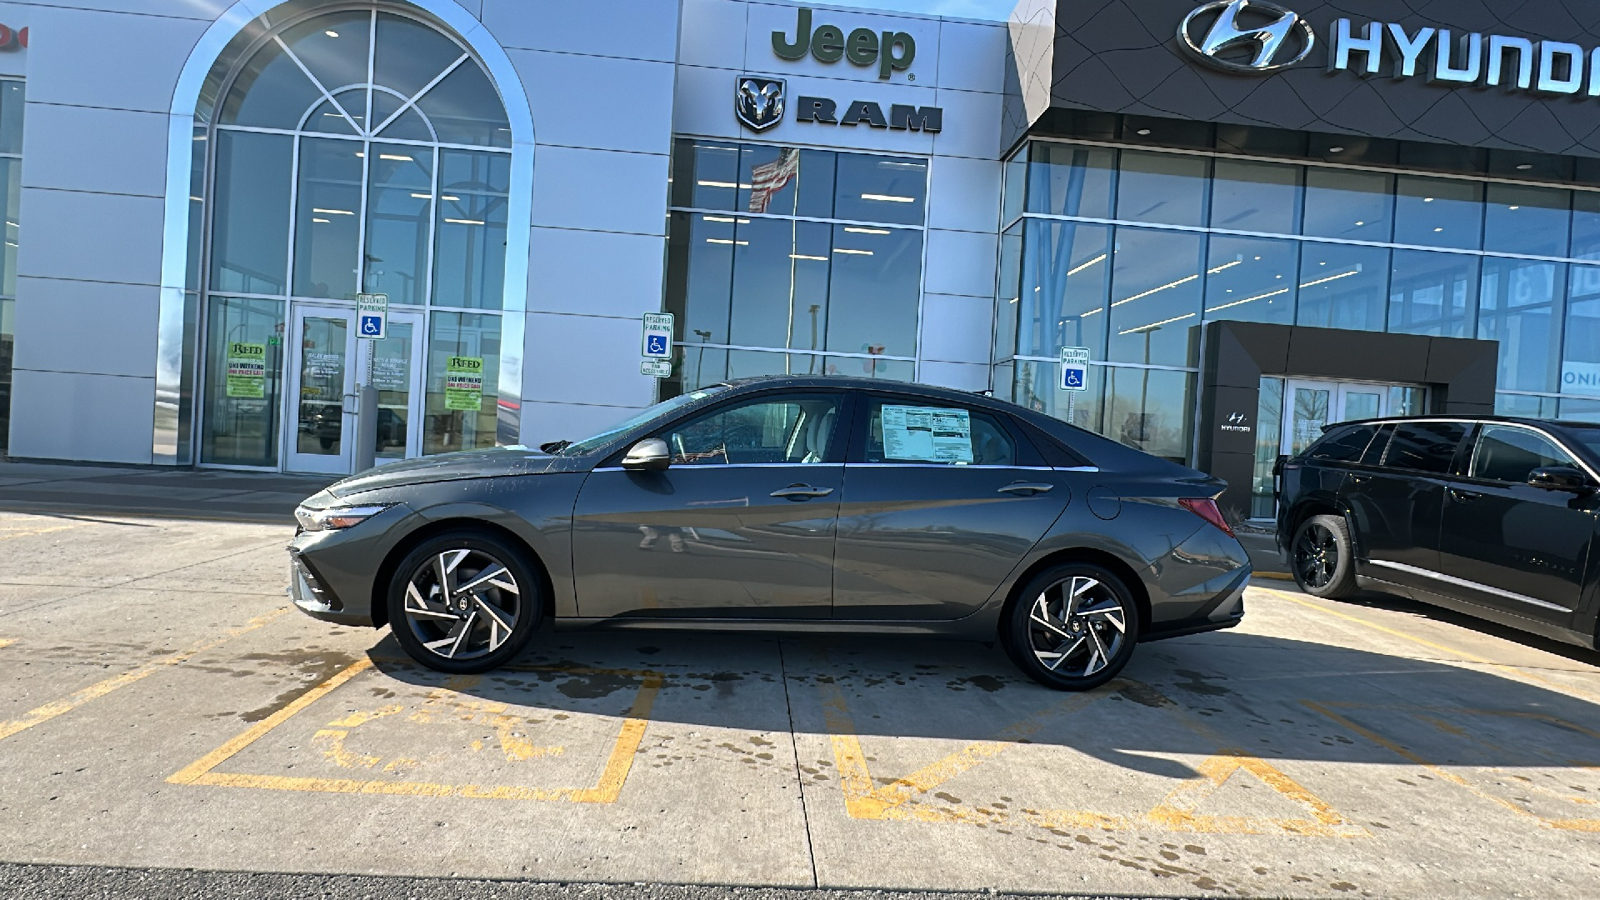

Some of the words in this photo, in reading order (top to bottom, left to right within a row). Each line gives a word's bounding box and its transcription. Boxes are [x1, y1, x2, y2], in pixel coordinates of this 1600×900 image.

[772, 7, 916, 79] Jeep
[797, 95, 943, 133] RAM
[360, 296, 385, 304] RESERVED
[360, 304, 385, 312] PARKING
[646, 316, 671, 324] RESERVED
[646, 324, 671, 332] PARKING
[233, 343, 263, 355] REED
[1064, 351, 1088, 359] RESERVED
[452, 357, 481, 369] REED
[1564, 371, 1600, 386] ONI
[1221, 424, 1251, 432] HYUNDAI
